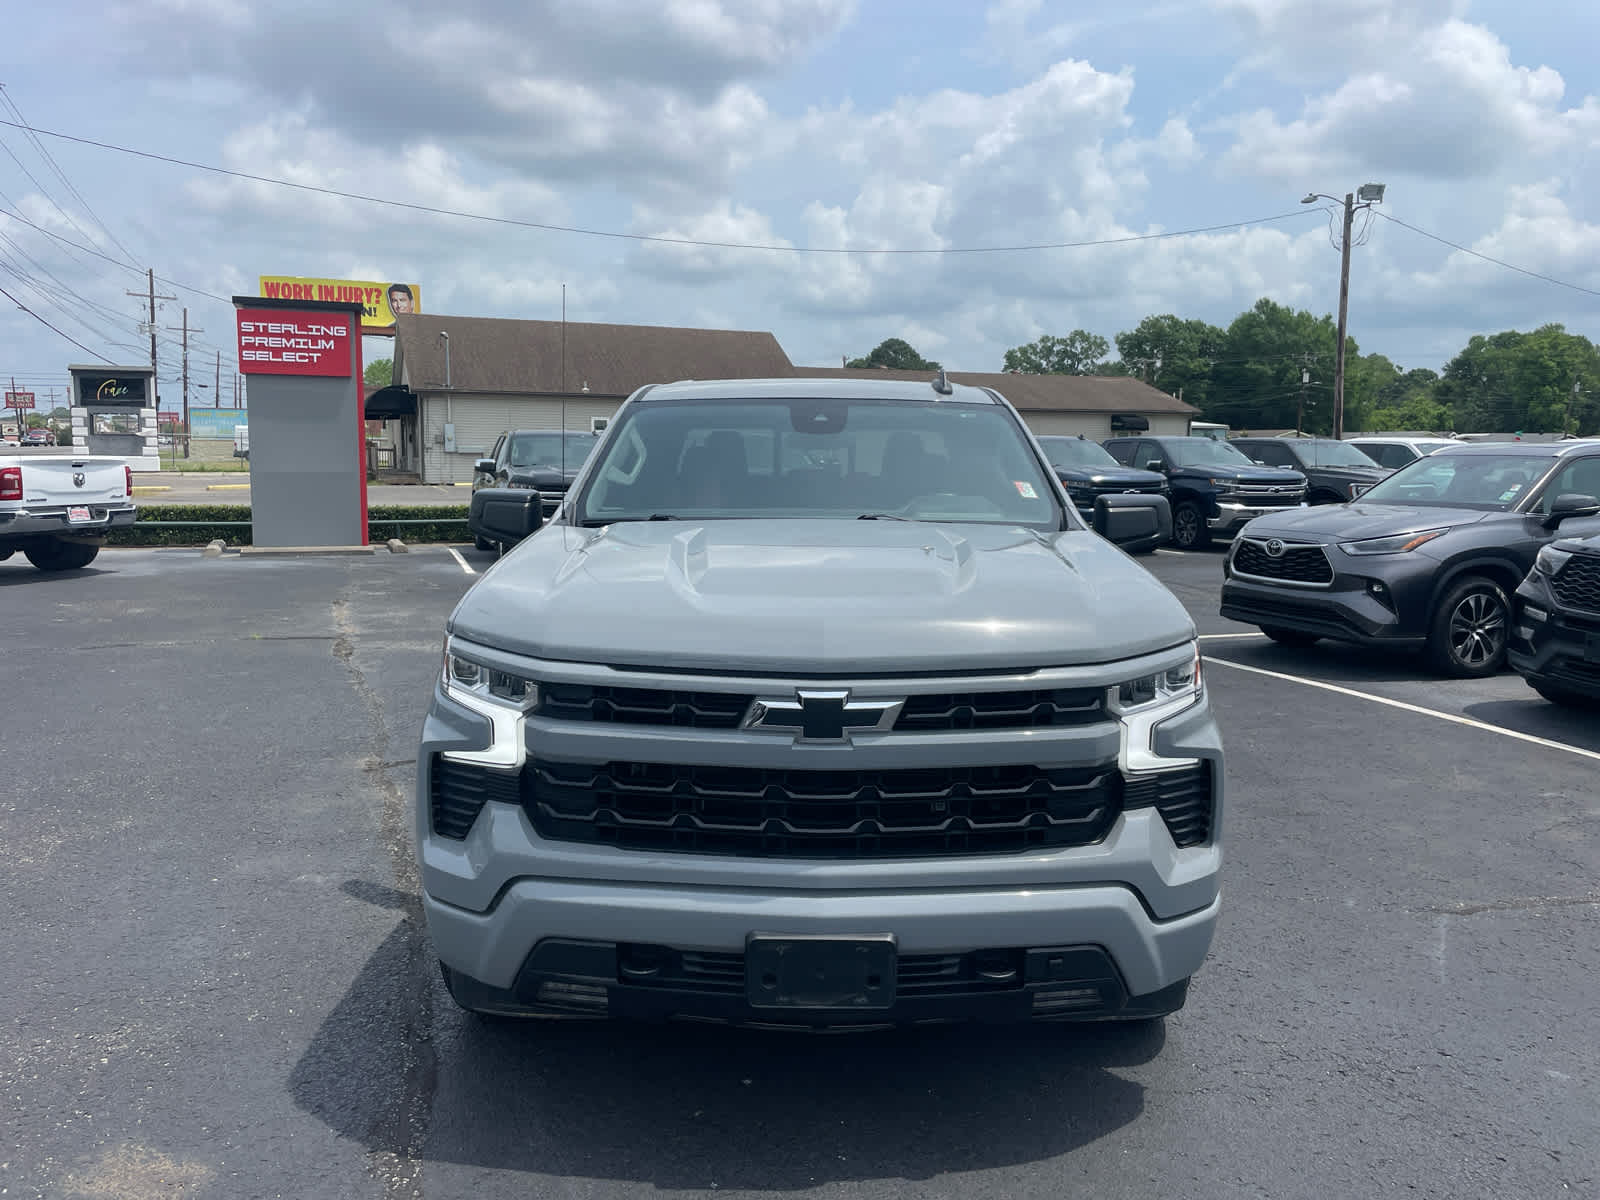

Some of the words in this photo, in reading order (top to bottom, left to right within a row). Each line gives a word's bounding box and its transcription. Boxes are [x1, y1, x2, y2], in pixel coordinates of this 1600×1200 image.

[264, 282, 313, 300] WORK
[317, 284, 382, 304] INJURY?
[241, 322, 346, 336] STERLING
[241, 336, 334, 349] PREMIUM
[242, 350, 321, 363] SELECT
